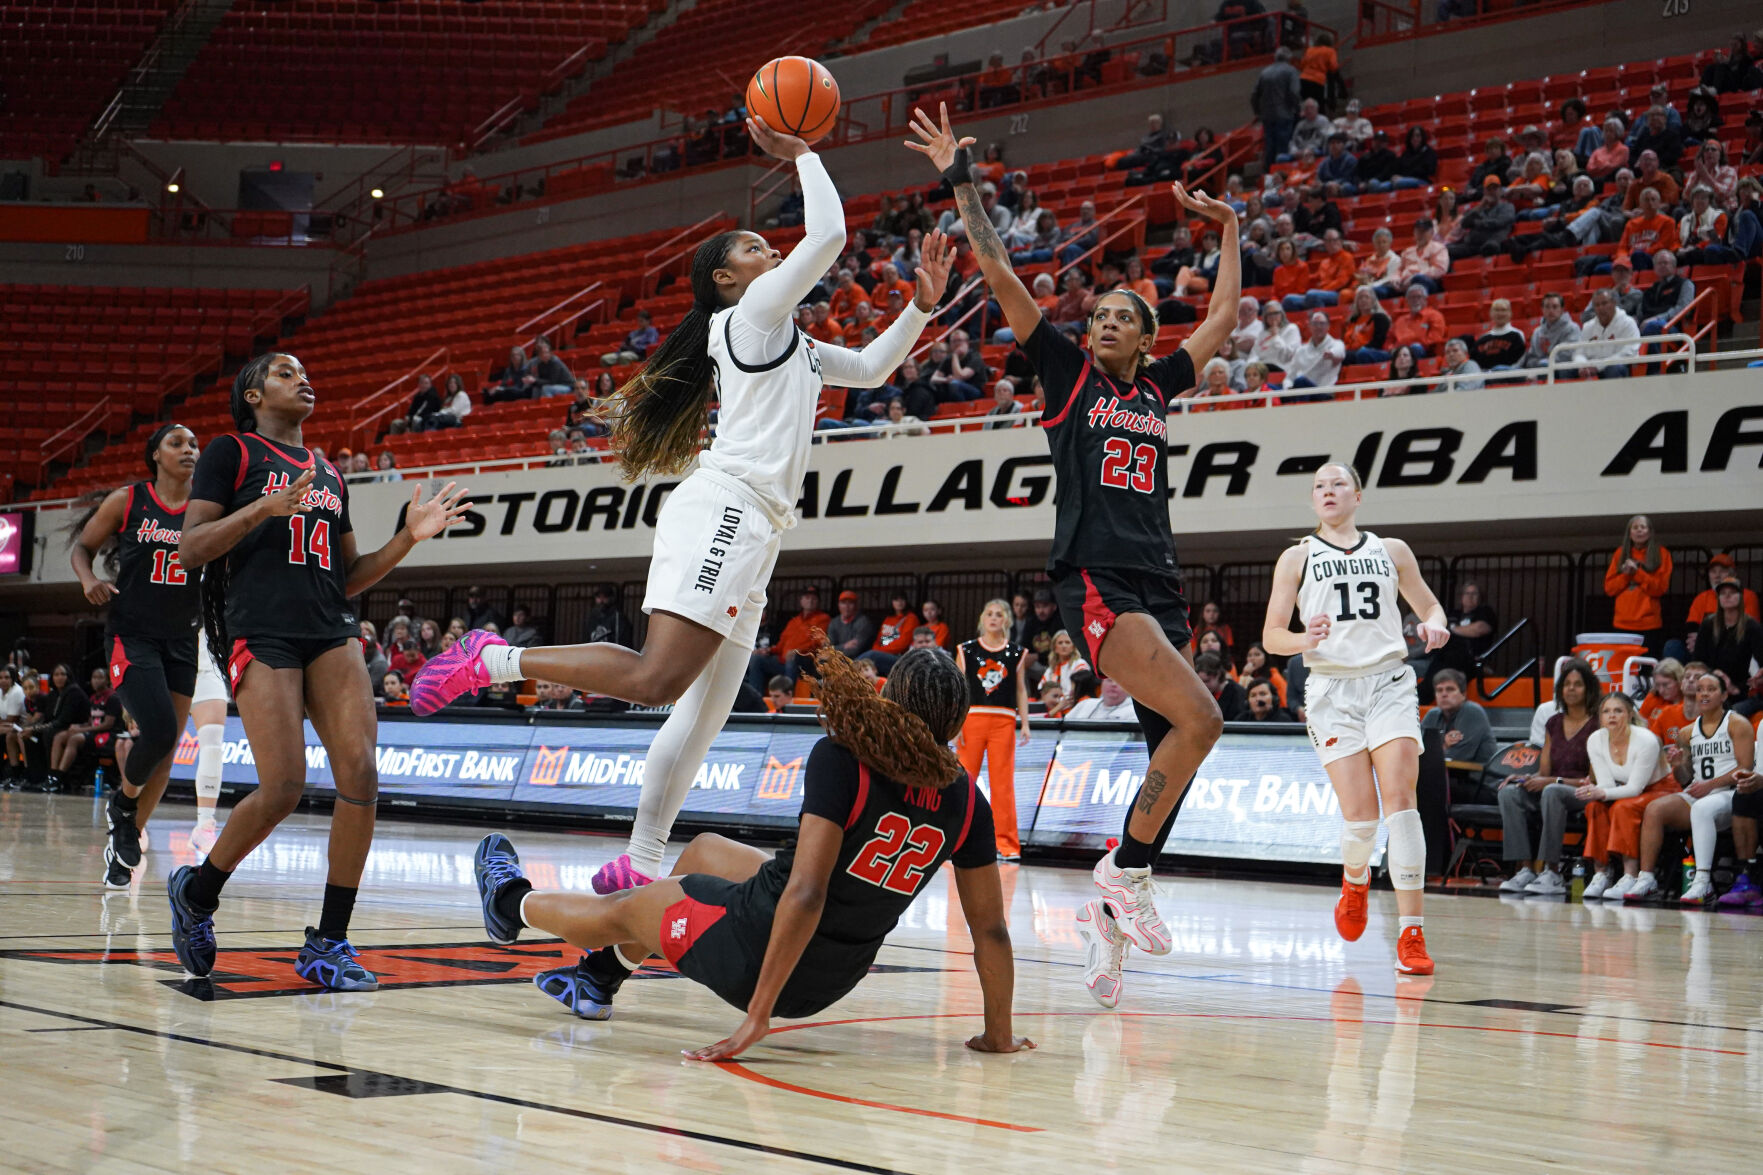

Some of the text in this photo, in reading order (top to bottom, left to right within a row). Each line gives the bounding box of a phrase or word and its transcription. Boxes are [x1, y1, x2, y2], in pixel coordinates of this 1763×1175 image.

[65, 244, 85, 260] 210
[1101, 437, 1158, 494] 23
[288, 514, 331, 571] 14
[694, 506, 743, 594] LOYAL & TRUE
[150, 549, 188, 585] 12
[1312, 558, 1390, 582] COWGIRLS
[1333, 581, 1381, 622] 13
[458, 750, 519, 781] BANK
[1700, 756, 1715, 780] 6
[846, 811, 946, 896] 22
